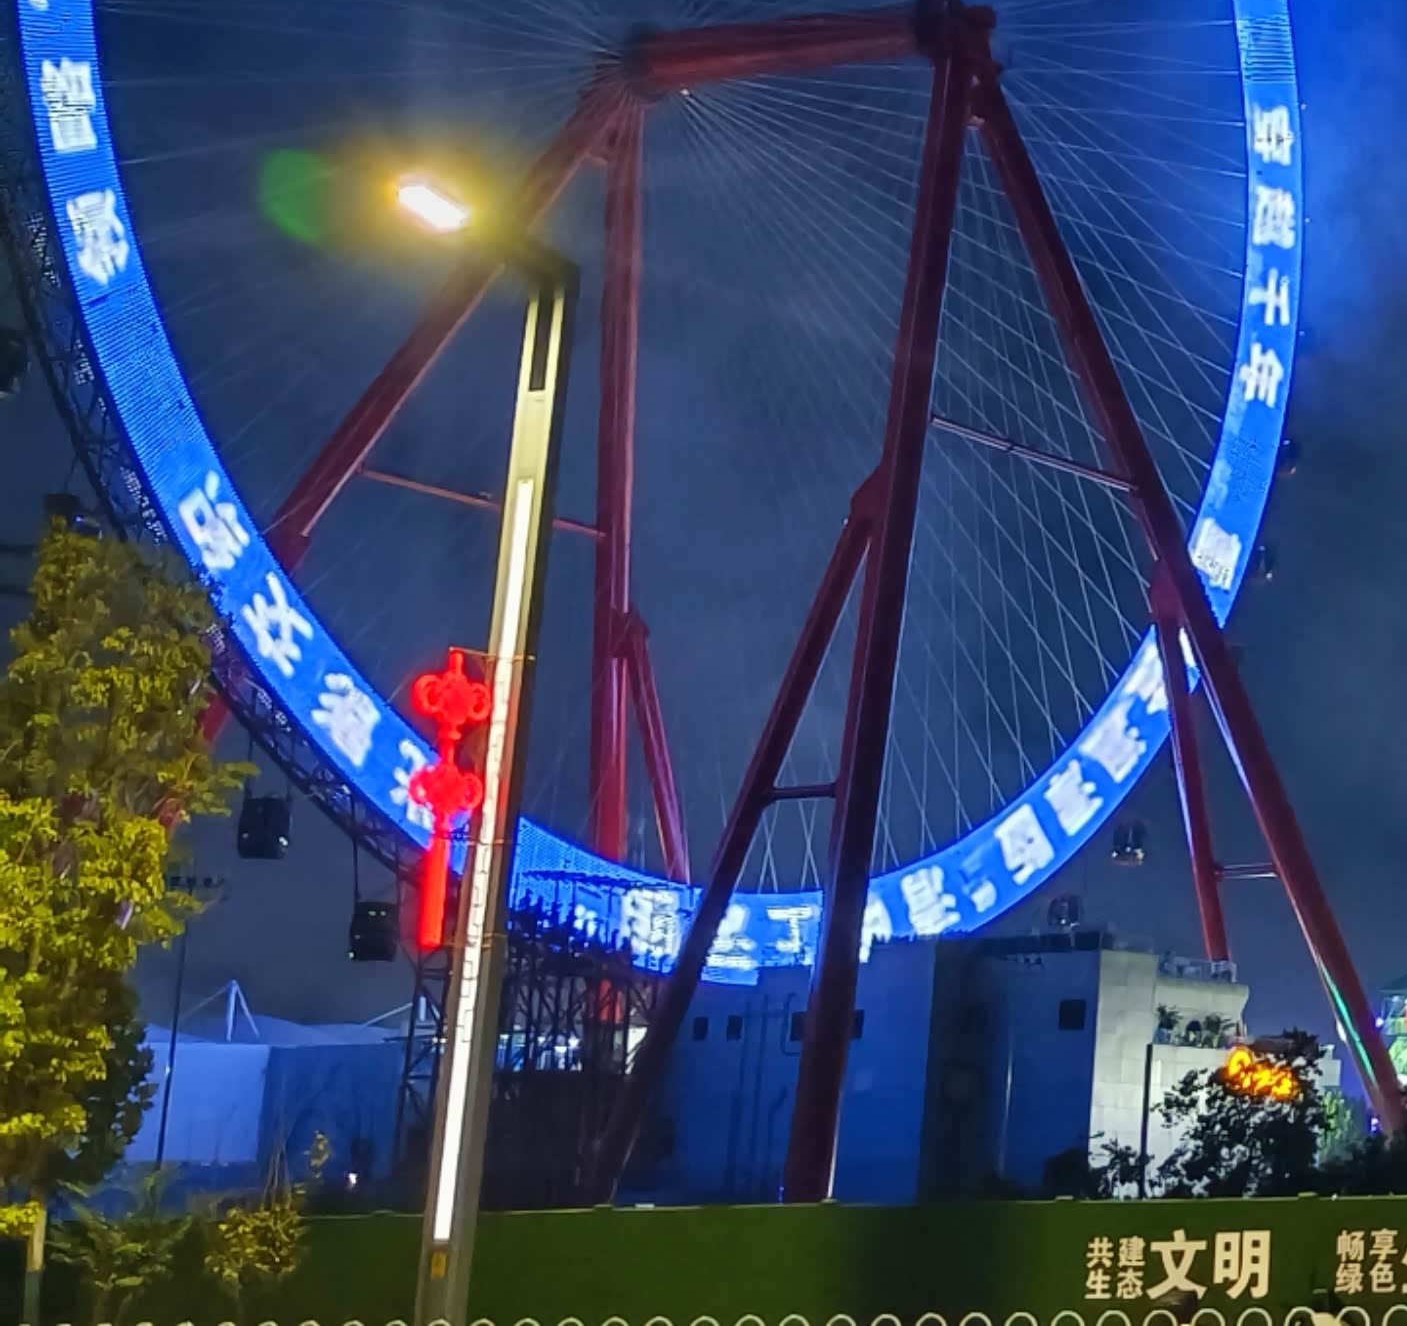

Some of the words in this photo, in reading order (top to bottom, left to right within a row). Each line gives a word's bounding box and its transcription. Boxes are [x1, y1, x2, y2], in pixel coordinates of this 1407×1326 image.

[1237, 105, 1296, 407] 穿越千年
[1086, 1235, 1145, 1267] 共建
[1336, 1228, 1398, 1262] 畅享
[1146, 1229, 1271, 1299] 文明
[1335, 1262, 1396, 1295] 绿色
[1084, 1268, 1143, 1299] 生态
